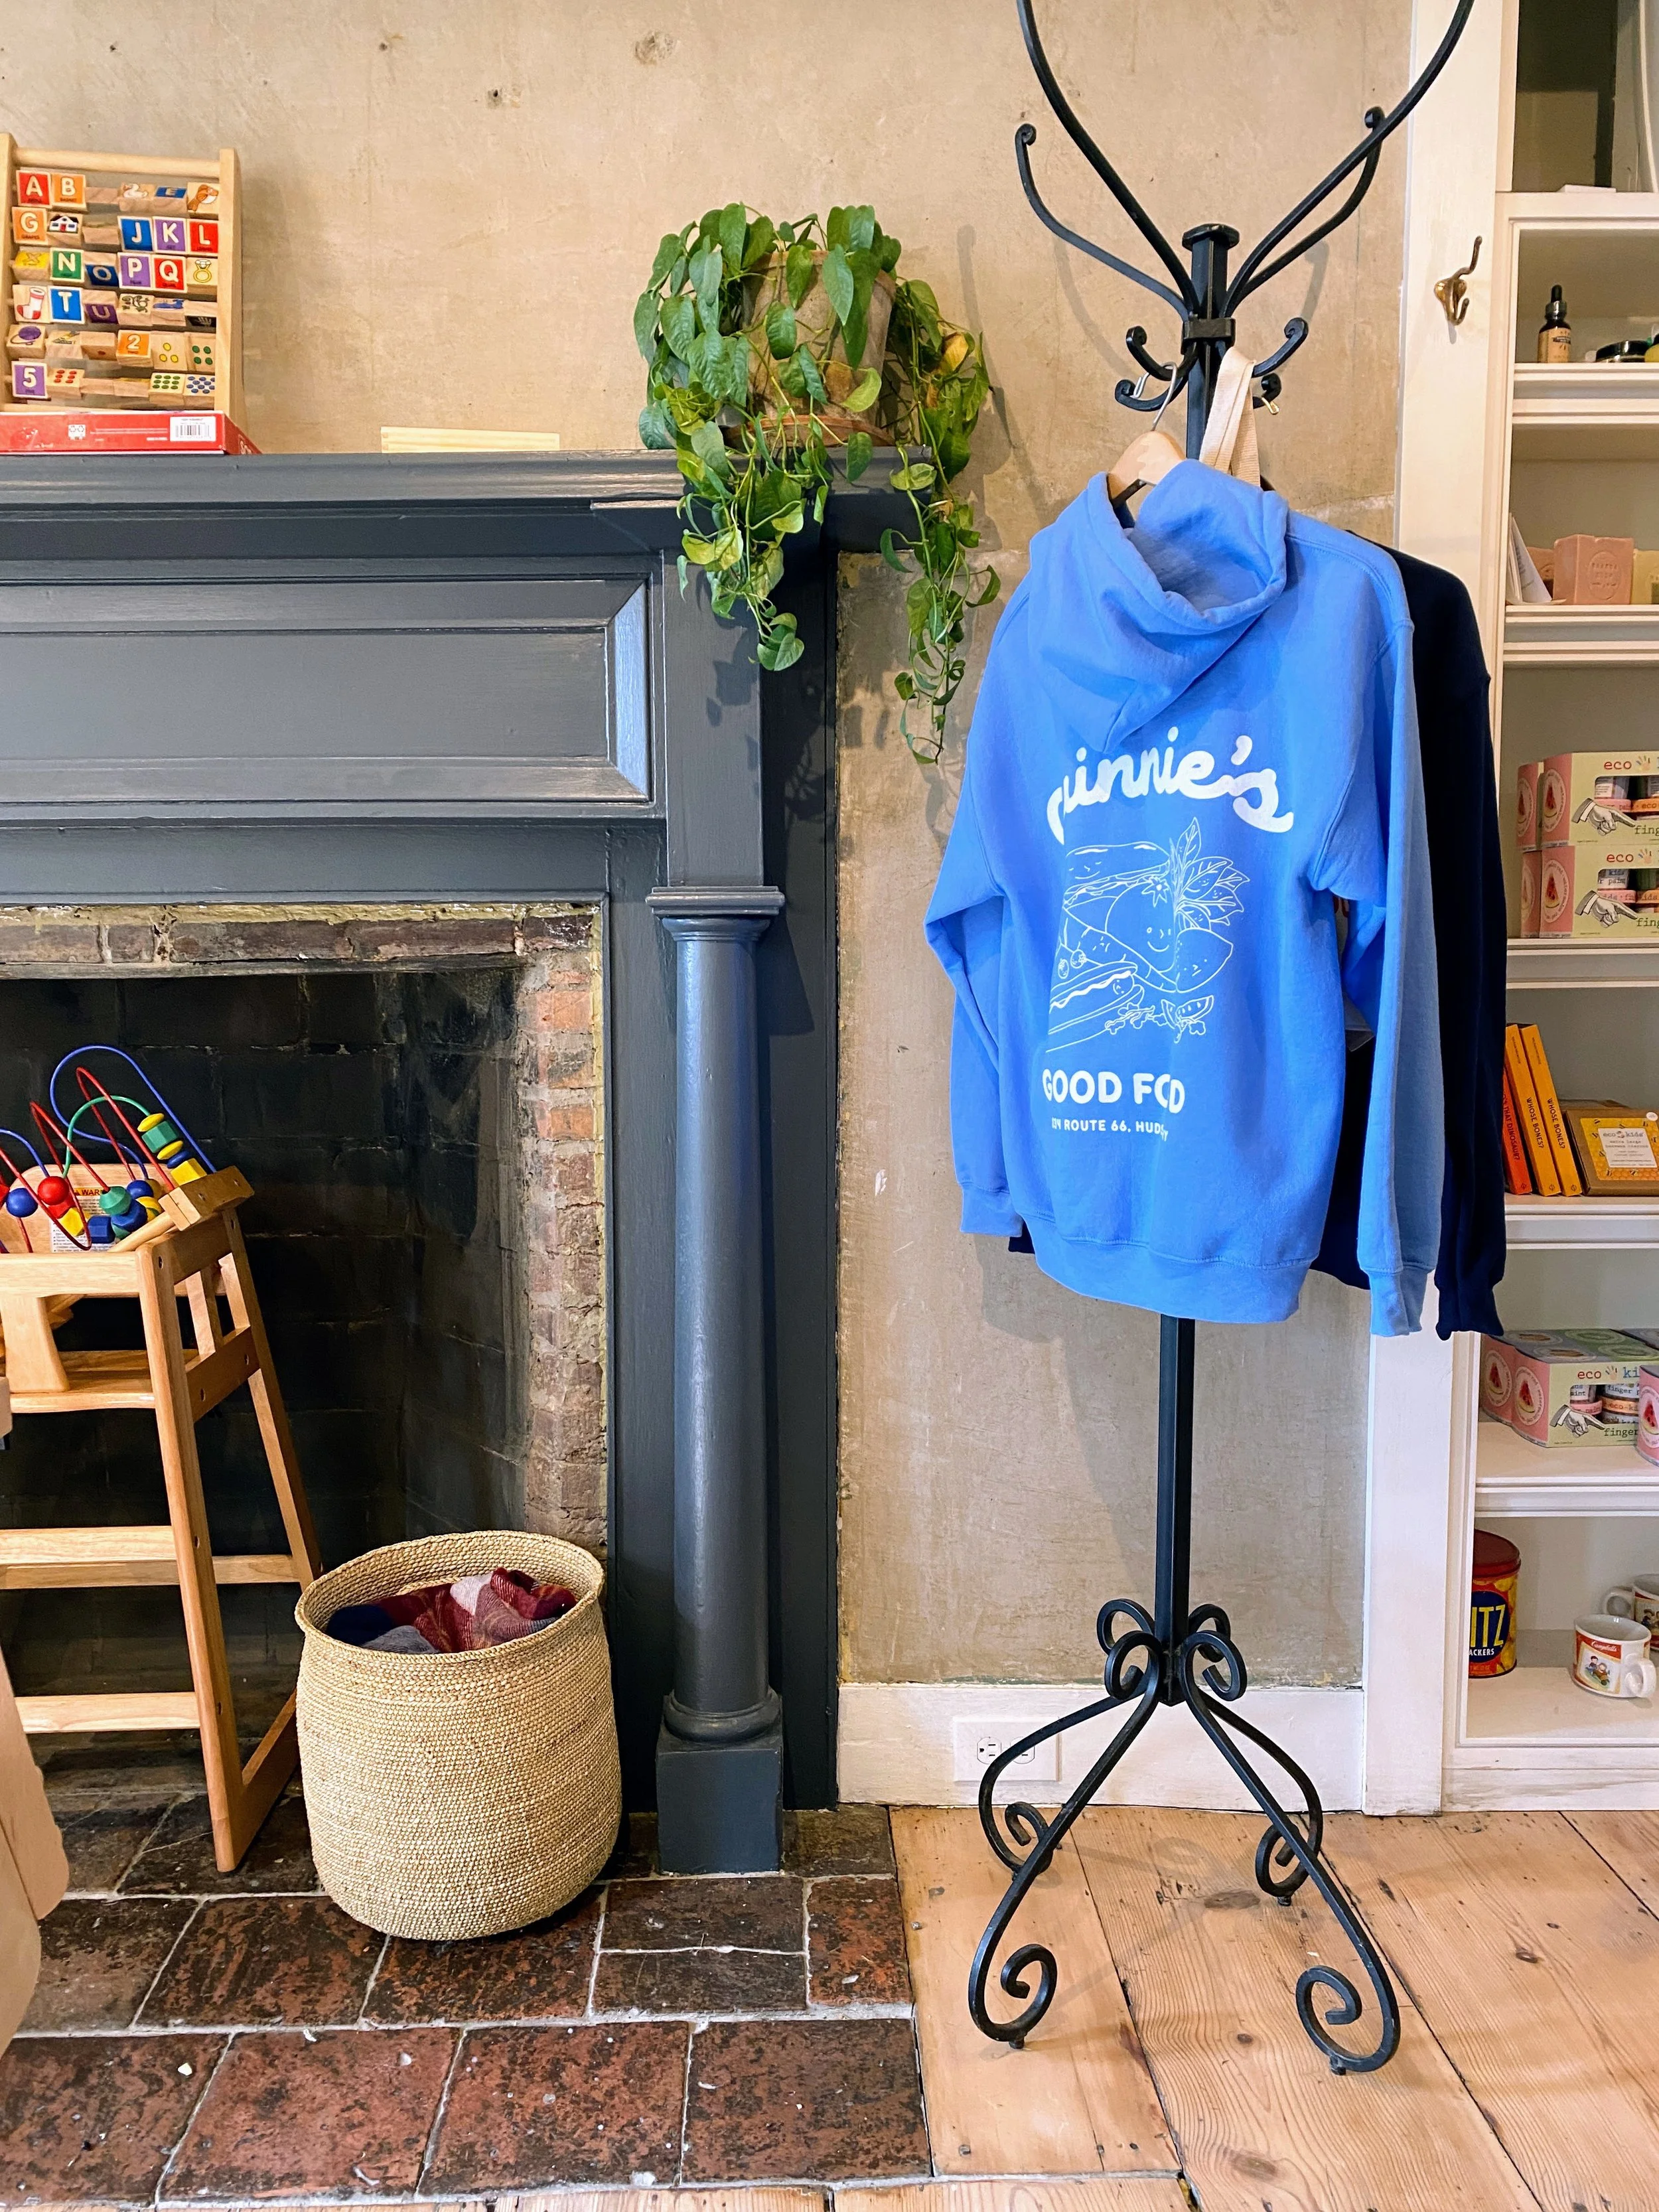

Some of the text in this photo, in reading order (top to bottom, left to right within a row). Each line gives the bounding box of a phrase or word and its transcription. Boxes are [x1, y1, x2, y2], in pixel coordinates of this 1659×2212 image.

[26, 175, 43, 197] A
[61, 177, 76, 196] B
[21, 212, 210, 245] G J K L
[58, 252, 76, 272] N
[92, 265, 111, 281] O
[127, 258, 143, 278] P
[159, 259, 179, 283] Q
[58, 291, 111, 319] T U
[127, 333, 141, 350] 2
[23, 366, 37, 388] 5
[1604, 761, 1632, 770] eco
[1607, 853, 1634, 863] eco
[1043, 1069, 1122, 1104] GOOD
[1064, 1119, 1106, 1131] ROUTE
[1111, 1120, 1131, 1132] 66,
[1526, 1097, 1544, 1149] WHOSE BONES?
[1547, 1097, 1565, 1149] WHOSE BONES?
[1577, 1366, 1640, 1379] eco ki
[1470, 1604, 1506, 1647] ITZ
